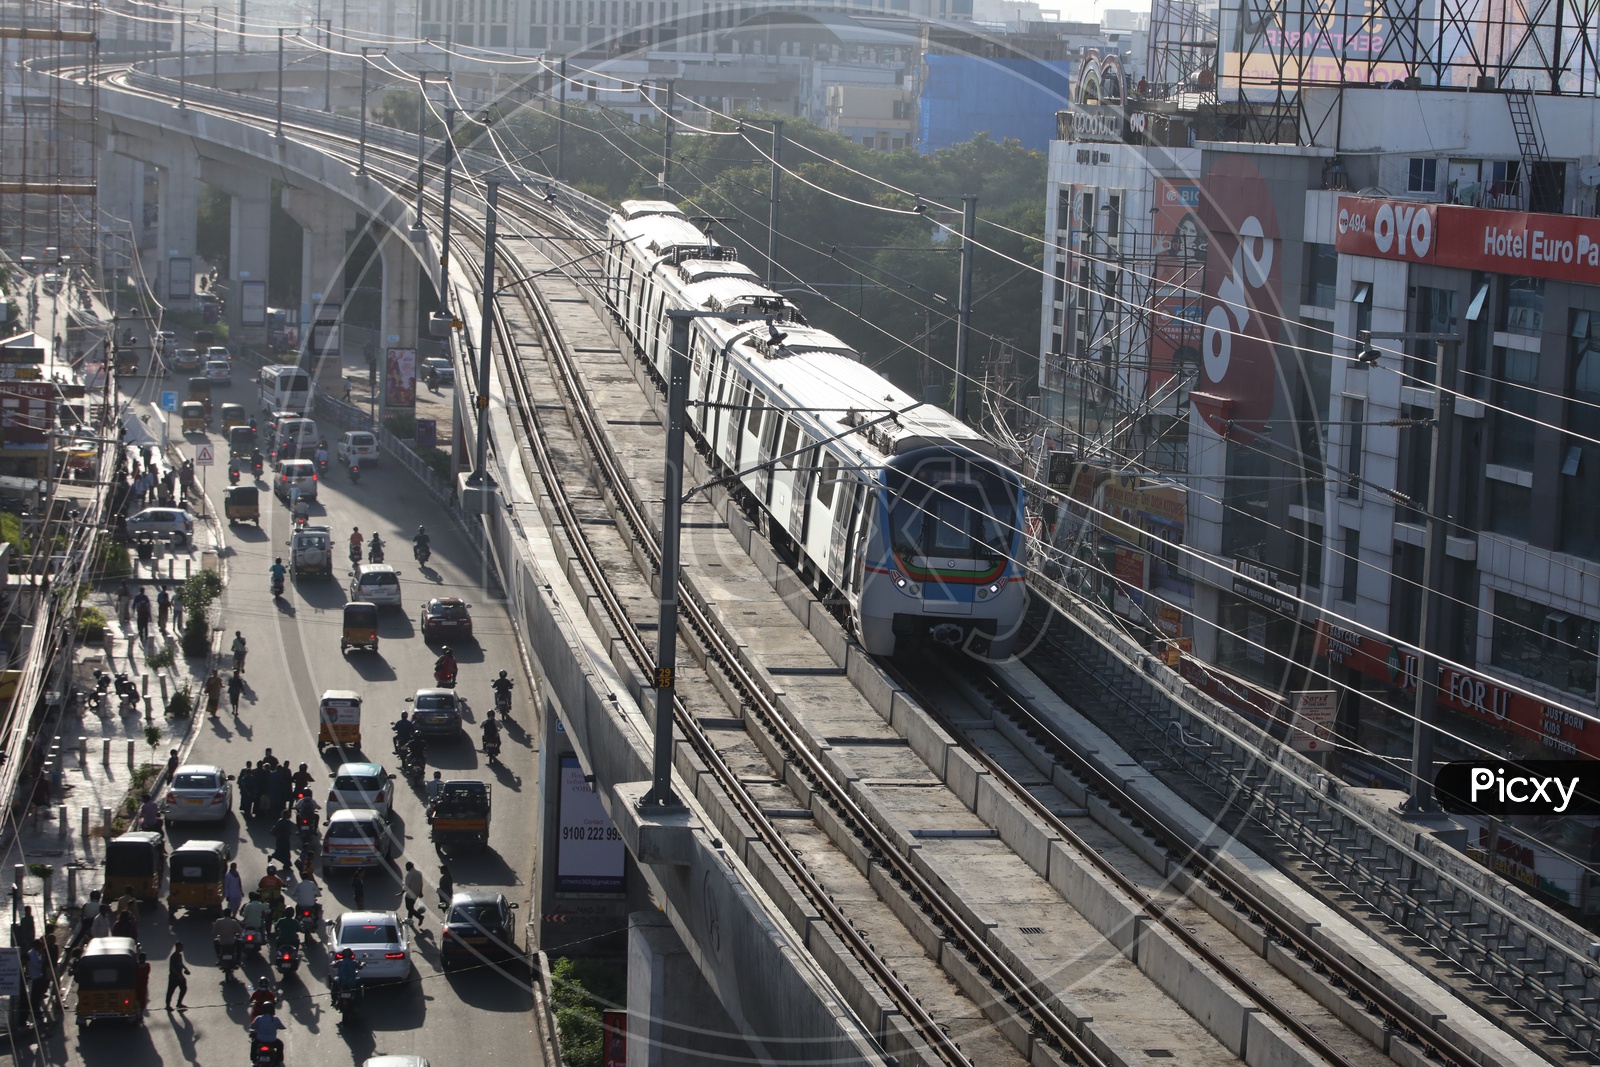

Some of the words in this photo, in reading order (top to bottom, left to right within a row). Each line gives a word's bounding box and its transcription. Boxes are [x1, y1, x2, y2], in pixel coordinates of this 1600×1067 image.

[1130, 113, 1145, 133] OYO
[1349, 213, 1367, 233] 494
[1374, 203, 1432, 258] OYO
[1484, 226, 1528, 259] Hotel
[1532, 230, 1573, 264] Euro
[1202, 215, 1274, 384] OYO
[18, 384, 47, 396] Place
[1329, 625, 1346, 641] BABY
[1328, 649, 1343, 664] TOYS
[659, 668, 671, 677] 29
[659, 678, 671, 688] 25
[1450, 672, 1487, 714] FOR
[1493, 687, 1508, 721] U
[1544, 720, 1561, 736] KIDS
[1545, 706, 1564, 723] JUST
[1565, 713, 1584, 731] BORN
[1542, 733, 1577, 756] MOTHERS
[563, 826, 585, 841] 9100
[587, 827, 604, 841] 222
